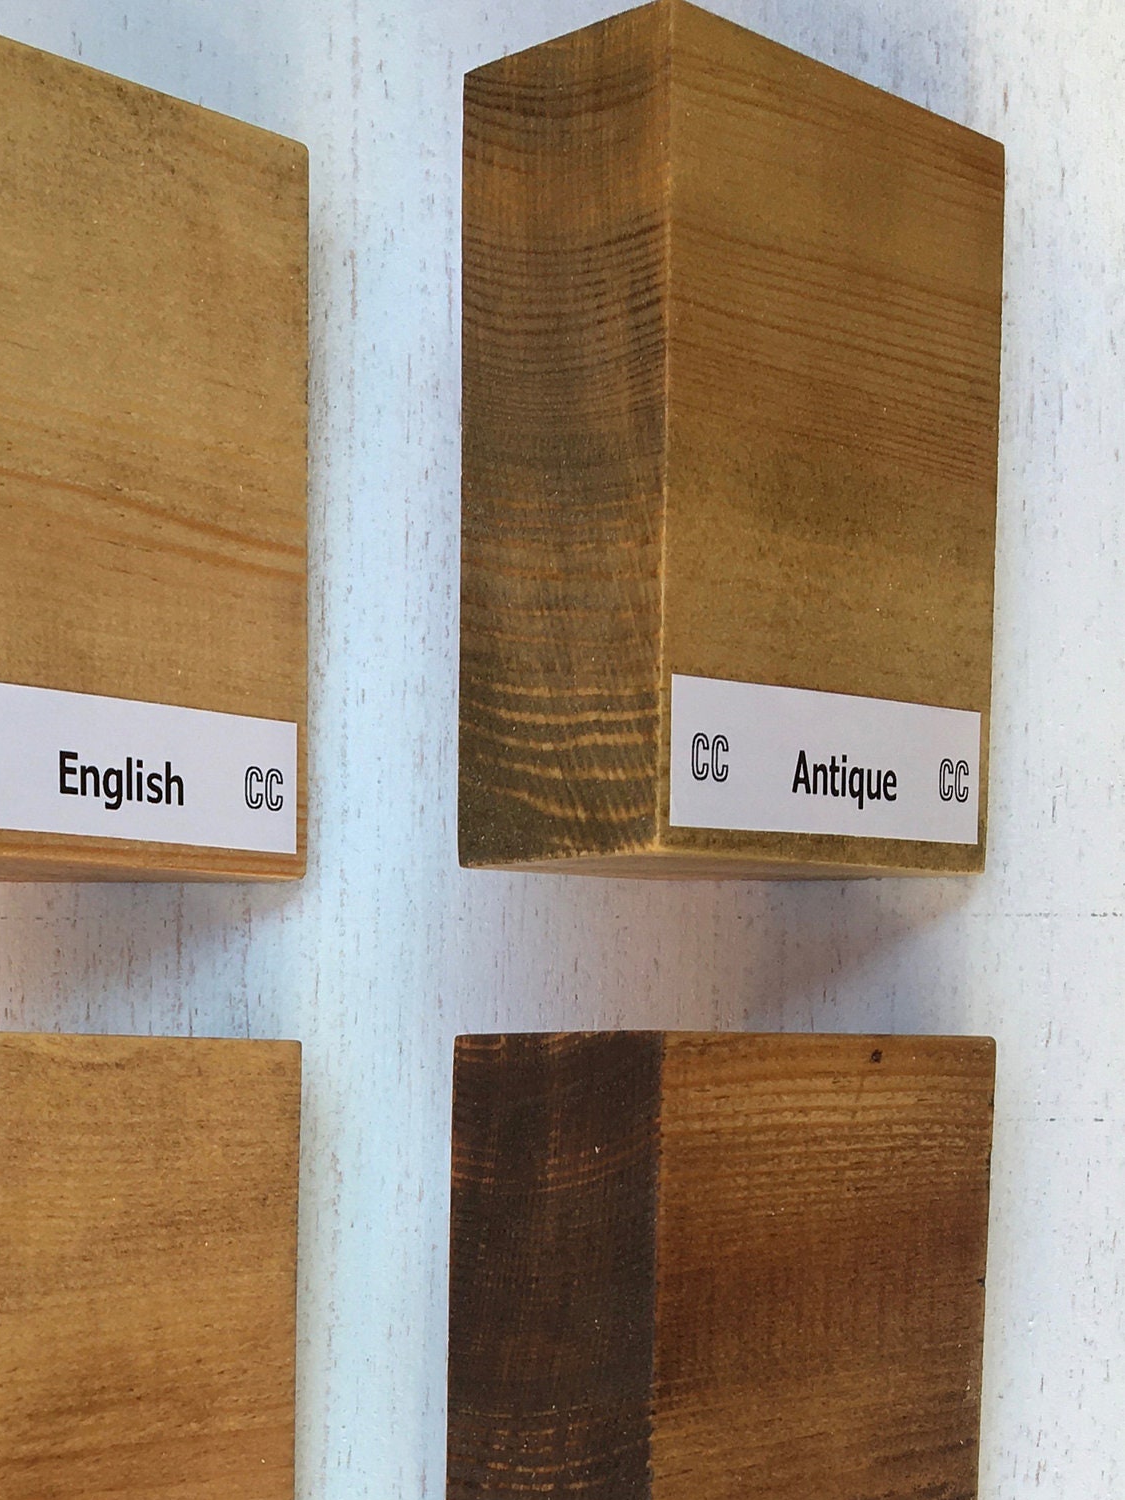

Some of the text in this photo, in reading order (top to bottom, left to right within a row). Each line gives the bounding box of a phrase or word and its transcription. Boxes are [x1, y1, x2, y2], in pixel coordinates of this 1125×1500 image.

[58, 749, 185, 811] English
[244, 765, 284, 812] CC
[691, 732, 970, 811] CC Antique CC
